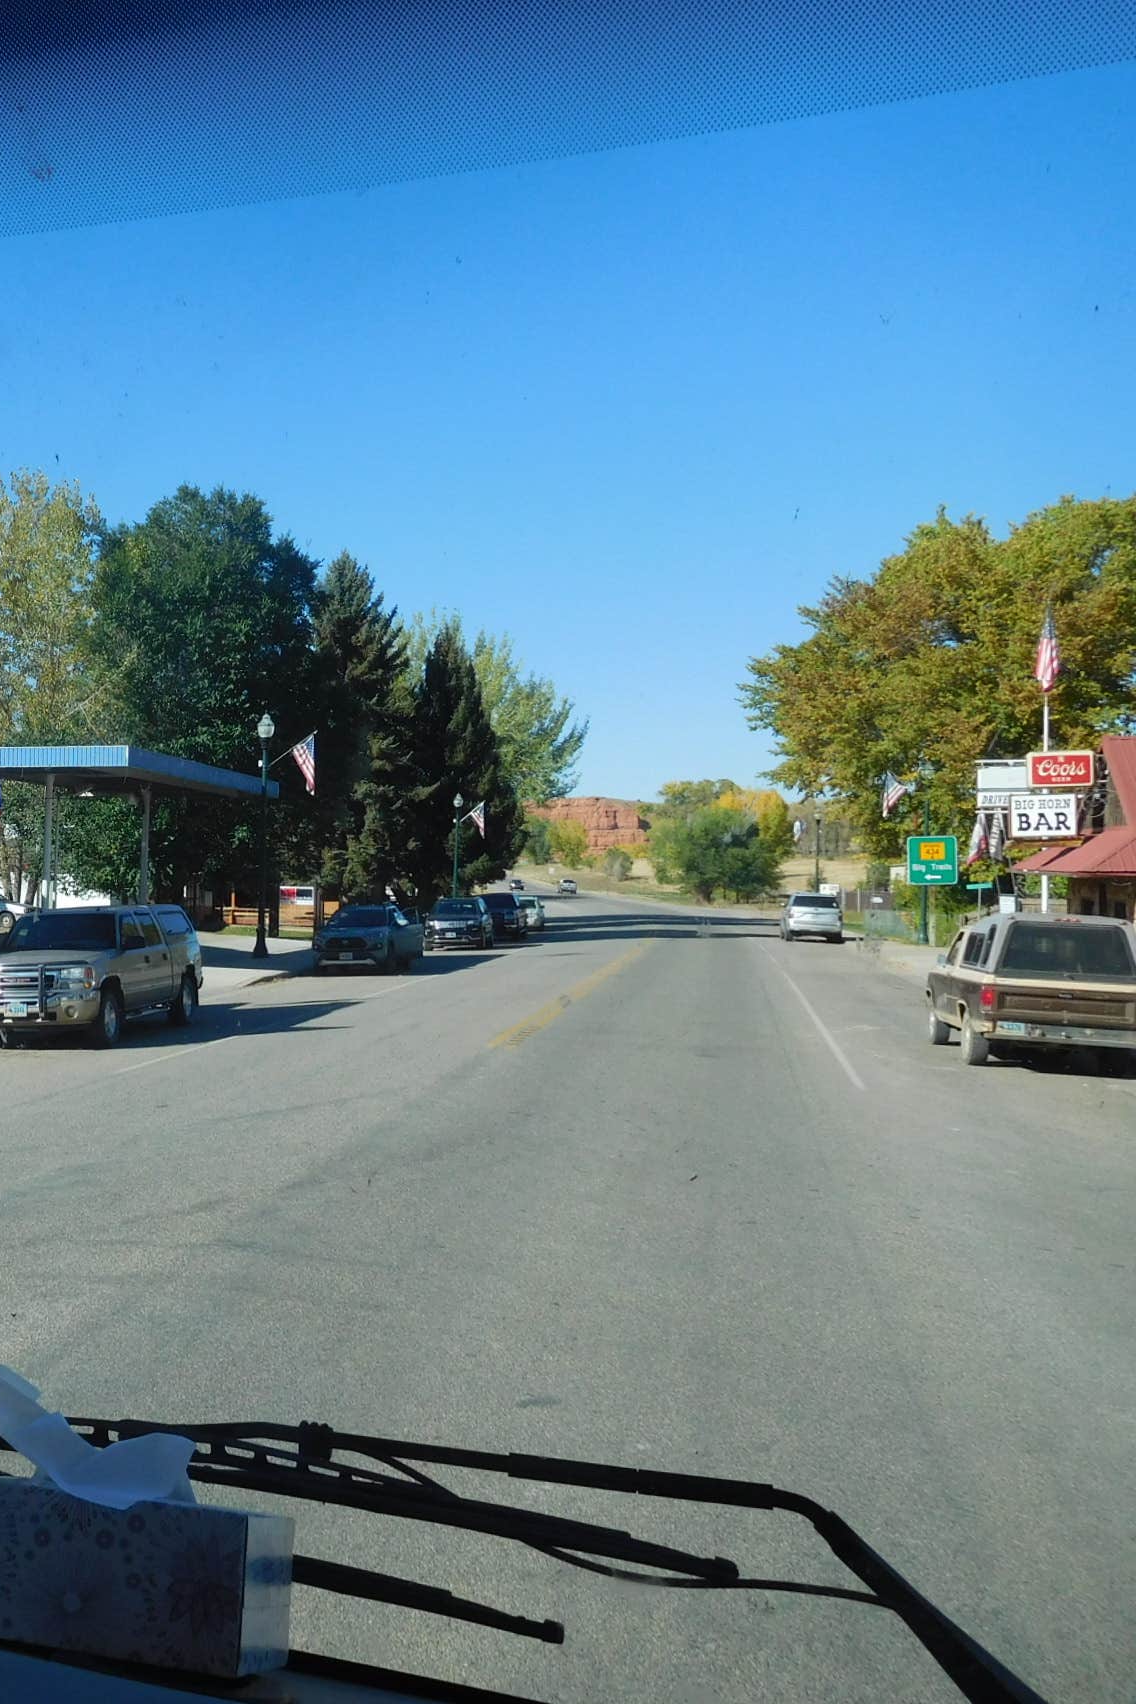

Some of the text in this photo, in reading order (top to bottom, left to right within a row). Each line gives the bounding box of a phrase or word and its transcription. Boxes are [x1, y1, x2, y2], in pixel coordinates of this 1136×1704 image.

[1036, 759, 1088, 777] Coors
[1014, 798, 1072, 810] BIG HORN
[1017, 812, 1072, 832] BAR
